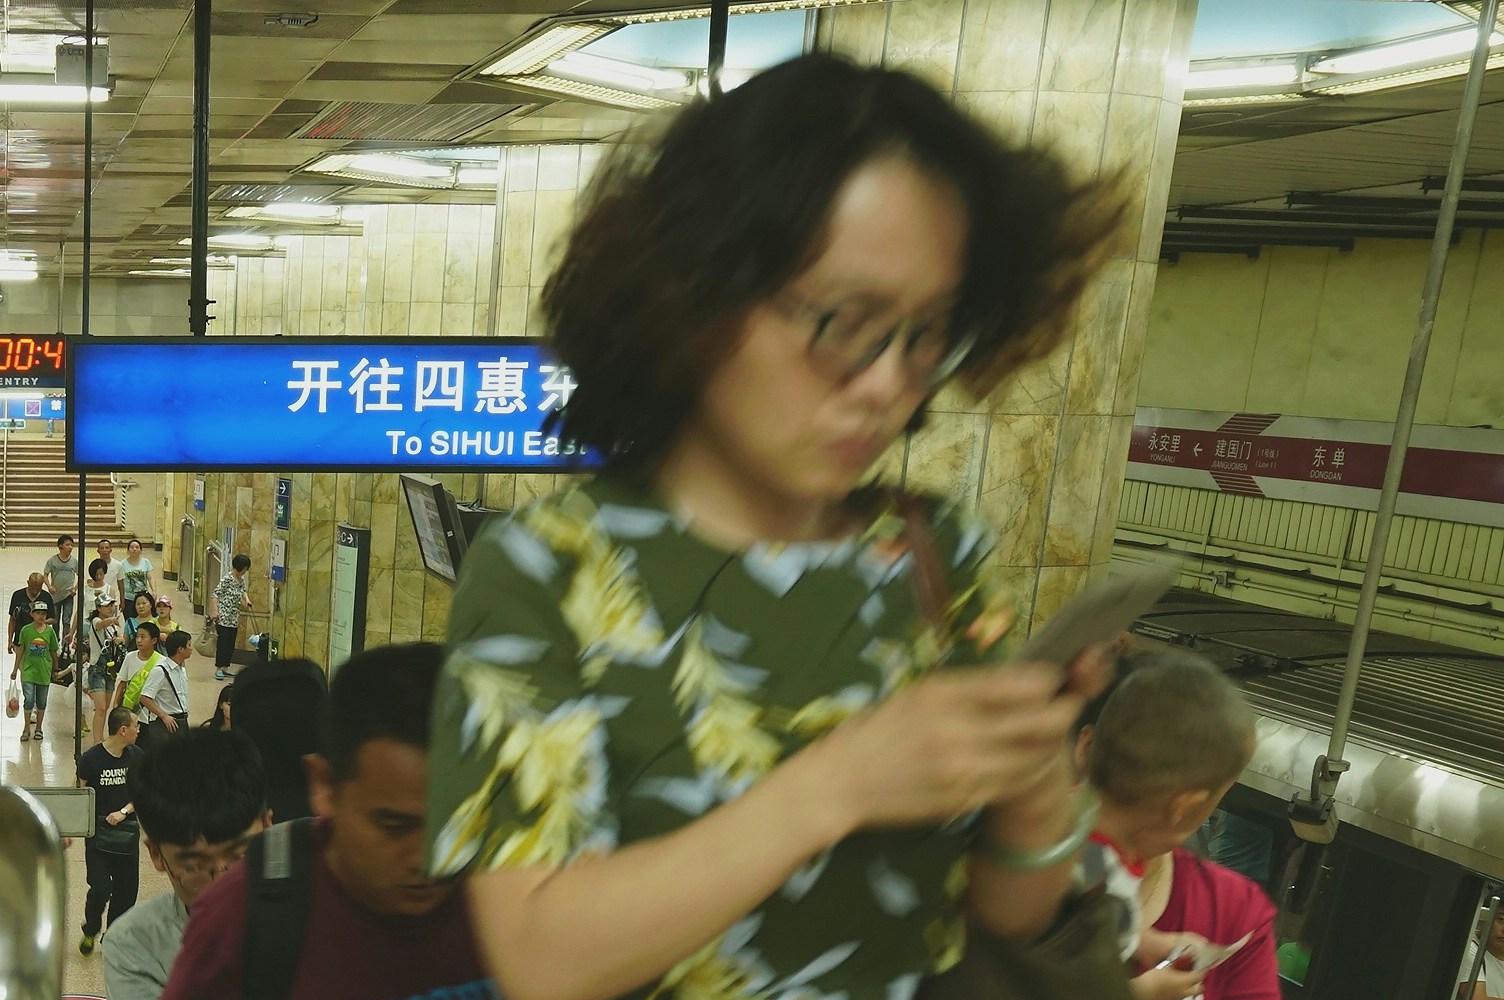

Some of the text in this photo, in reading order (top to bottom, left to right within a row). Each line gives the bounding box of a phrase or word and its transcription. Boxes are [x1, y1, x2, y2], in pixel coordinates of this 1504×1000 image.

[287, 357, 579, 413] 开往四惠东
[386, 431, 422, 456] To
[430, 430, 514, 456] SIHUI
[1148, 432, 1181, 453] 永安里
[1215, 438, 1252, 460] 建国门
[1312, 445, 1345, 469] 东单
[1310, 469, 1343, 481] DONGDAN
[100, 767, 129, 778] JOURN
